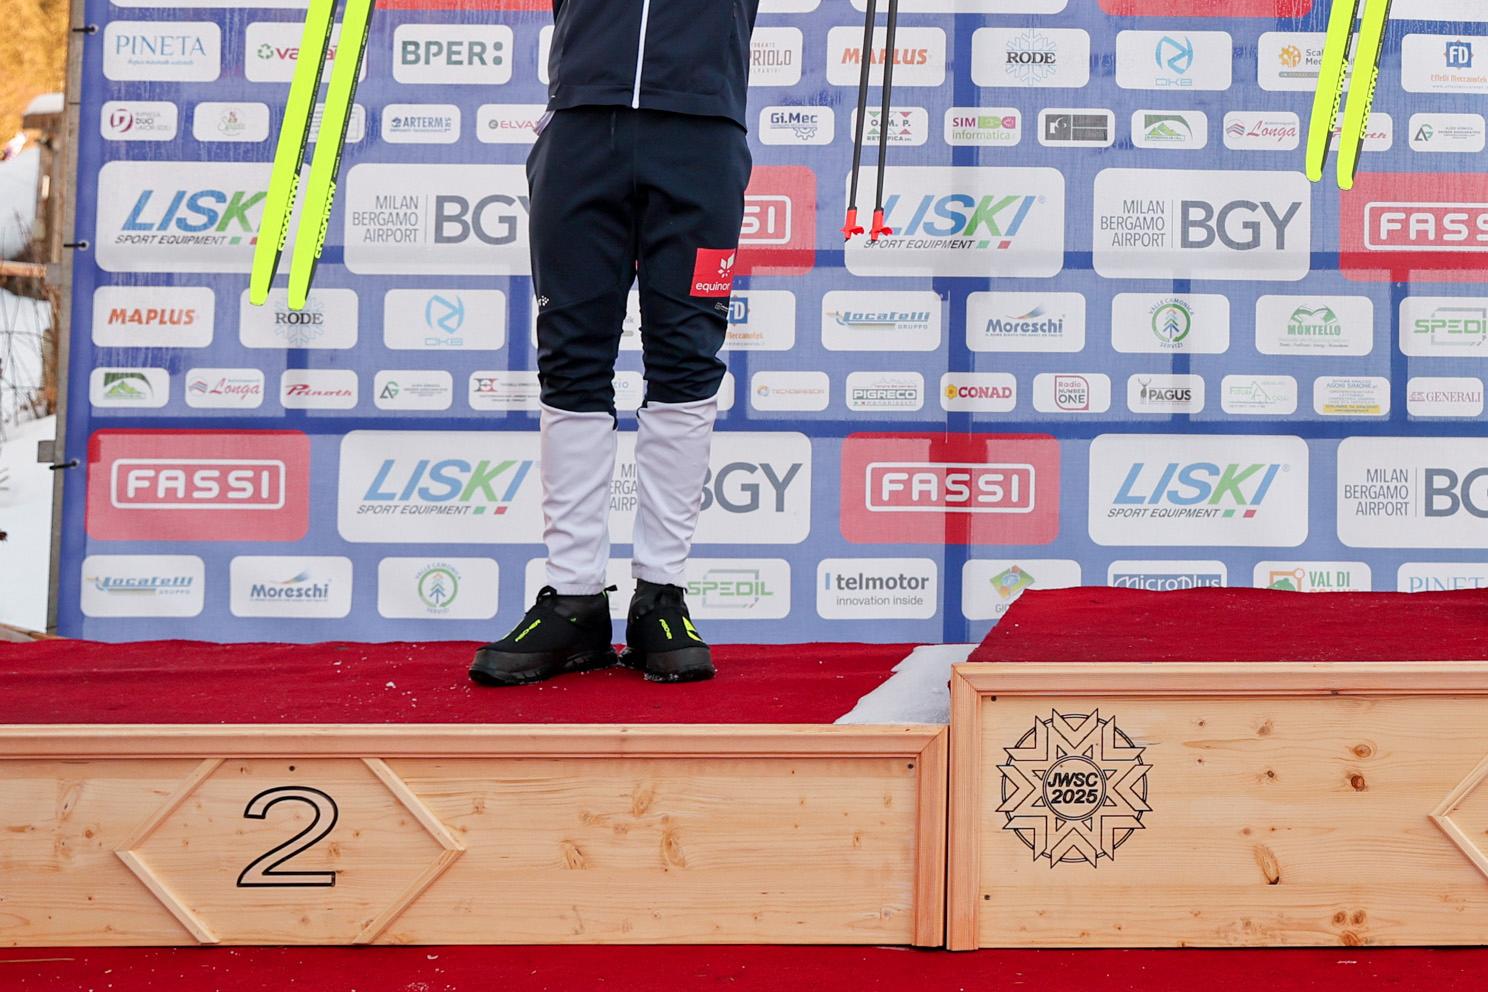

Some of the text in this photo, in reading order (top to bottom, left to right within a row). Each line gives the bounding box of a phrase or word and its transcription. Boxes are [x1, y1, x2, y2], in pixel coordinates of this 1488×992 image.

[116, 35, 206, 57] PINETA
[1006, 51, 1056, 65] RODE
[771, 112, 818, 124] Gi.Mec
[1247, 120, 1297, 142] Longa
[376, 196, 418, 210] MILAN
[1123, 200, 1165, 214] MILAN
[122, 190, 266, 232] LISK
[353, 212, 418, 227] BERGAMO
[1101, 216, 1165, 231] BERGAMO
[1181, 200, 1302, 250] BGY
[364, 228, 418, 244] AIRPORT
[1112, 232, 1166, 247] AIRPORT
[108, 309, 195, 325] MAPLUS
[275, 312, 324, 325] RODE
[986, 319, 1063, 334] Moreschi
[1287, 325, 1341, 336] MONTELLO
[210, 378, 260, 397] Longa
[853, 389, 917, 401] PIGRECO
[958, 386, 1012, 399] CONAD
[1149, 389, 1192, 401] PAGUS
[1058, 394, 1086, 404] ONE
[1426, 391, 1482, 402] GENERALI
[1366, 469, 1408, 483] MILAN
[127, 470, 269, 498] FASSI
[882, 473, 1019, 502] FASSI
[1113, 463, 1280, 505] LISKI
[1345, 484, 1409, 500] BERGAMO
[357, 504, 470, 516] SPORT EQUIPMENT
[1108, 508, 1220, 519] SPORT EQUIPMENT
[1355, 501, 1409, 516] AIRPORT
[836, 572, 930, 591] telmotor
[250, 583, 329, 599] Moreschi
[687, 581, 774, 598] SPEDIL
[836, 595, 924, 606] innovation inside
[1047, 772, 1099, 788] JWSC
[1050, 789, 1099, 804] 2025
[236, 786, 339, 888] 2
